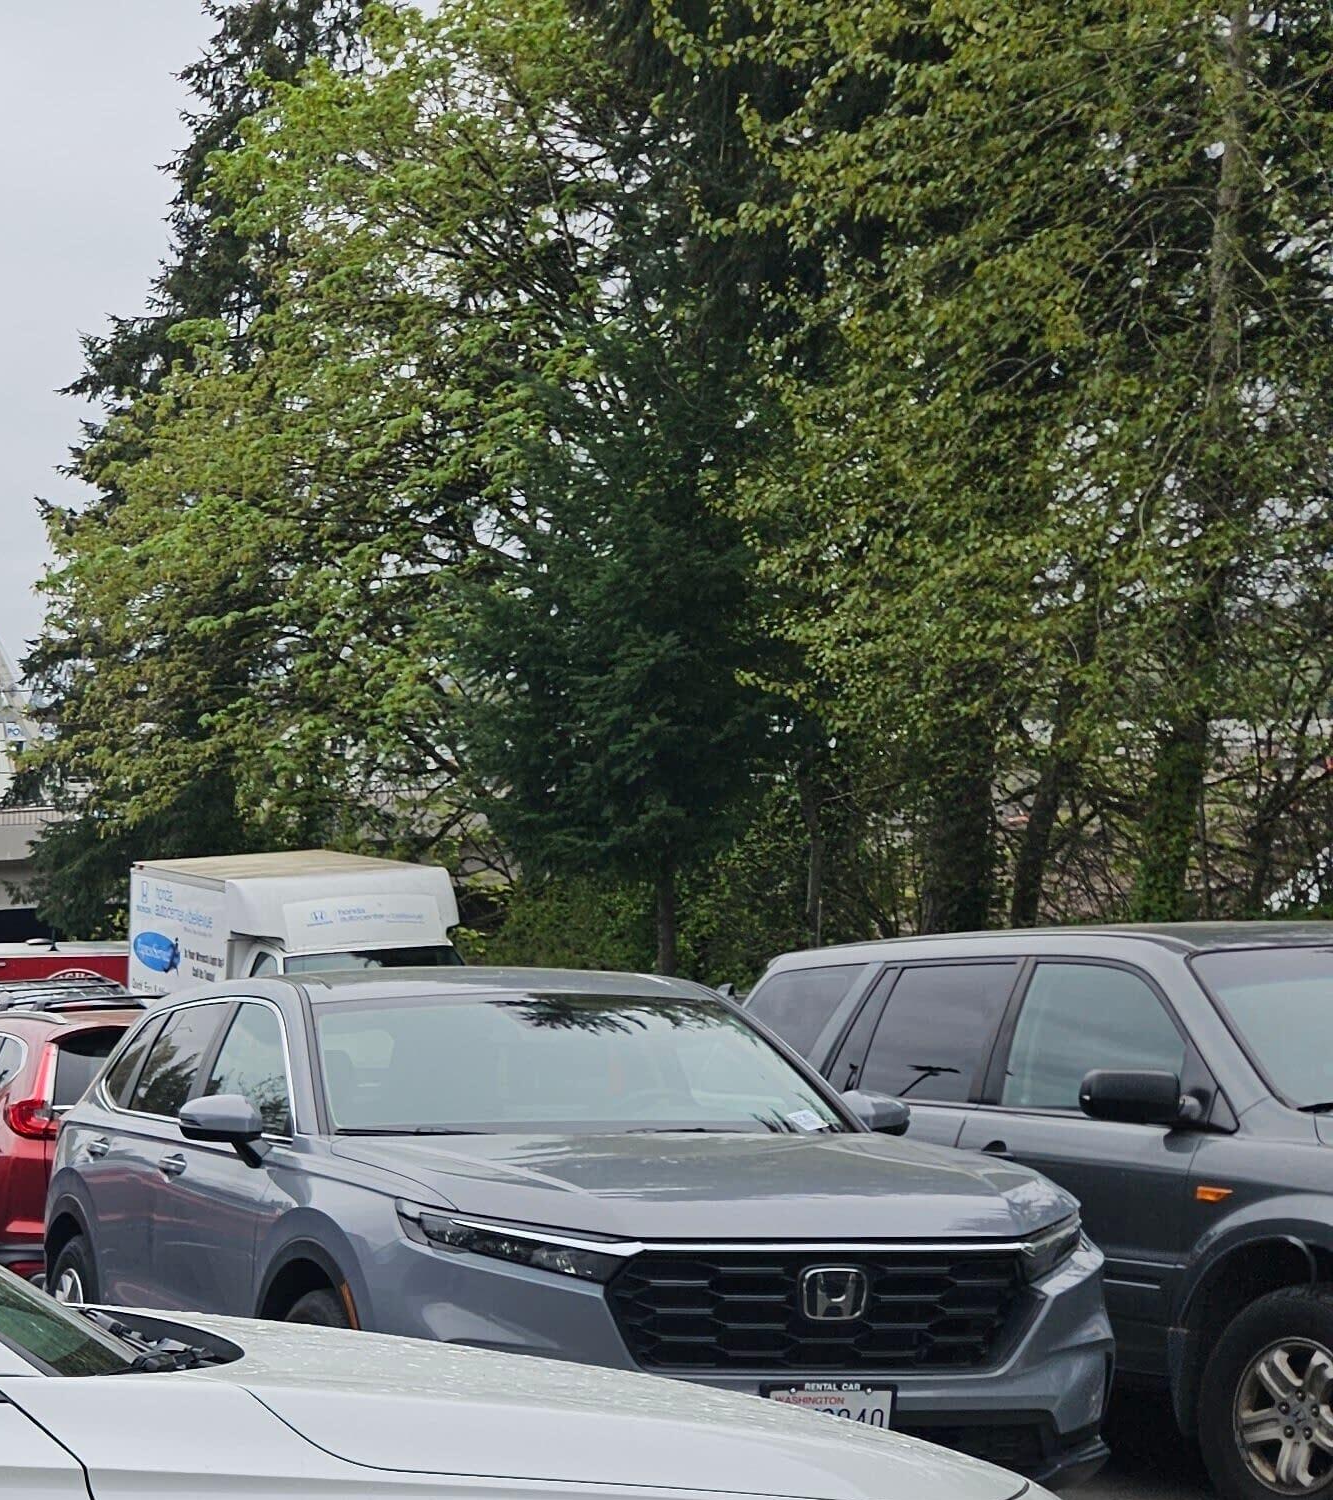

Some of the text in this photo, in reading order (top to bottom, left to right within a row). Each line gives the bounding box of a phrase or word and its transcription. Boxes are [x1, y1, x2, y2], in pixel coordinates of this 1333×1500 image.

[804, 1383, 861, 1391] RENTAL CAR
[775, 1396, 845, 1405] WASHINGTON
